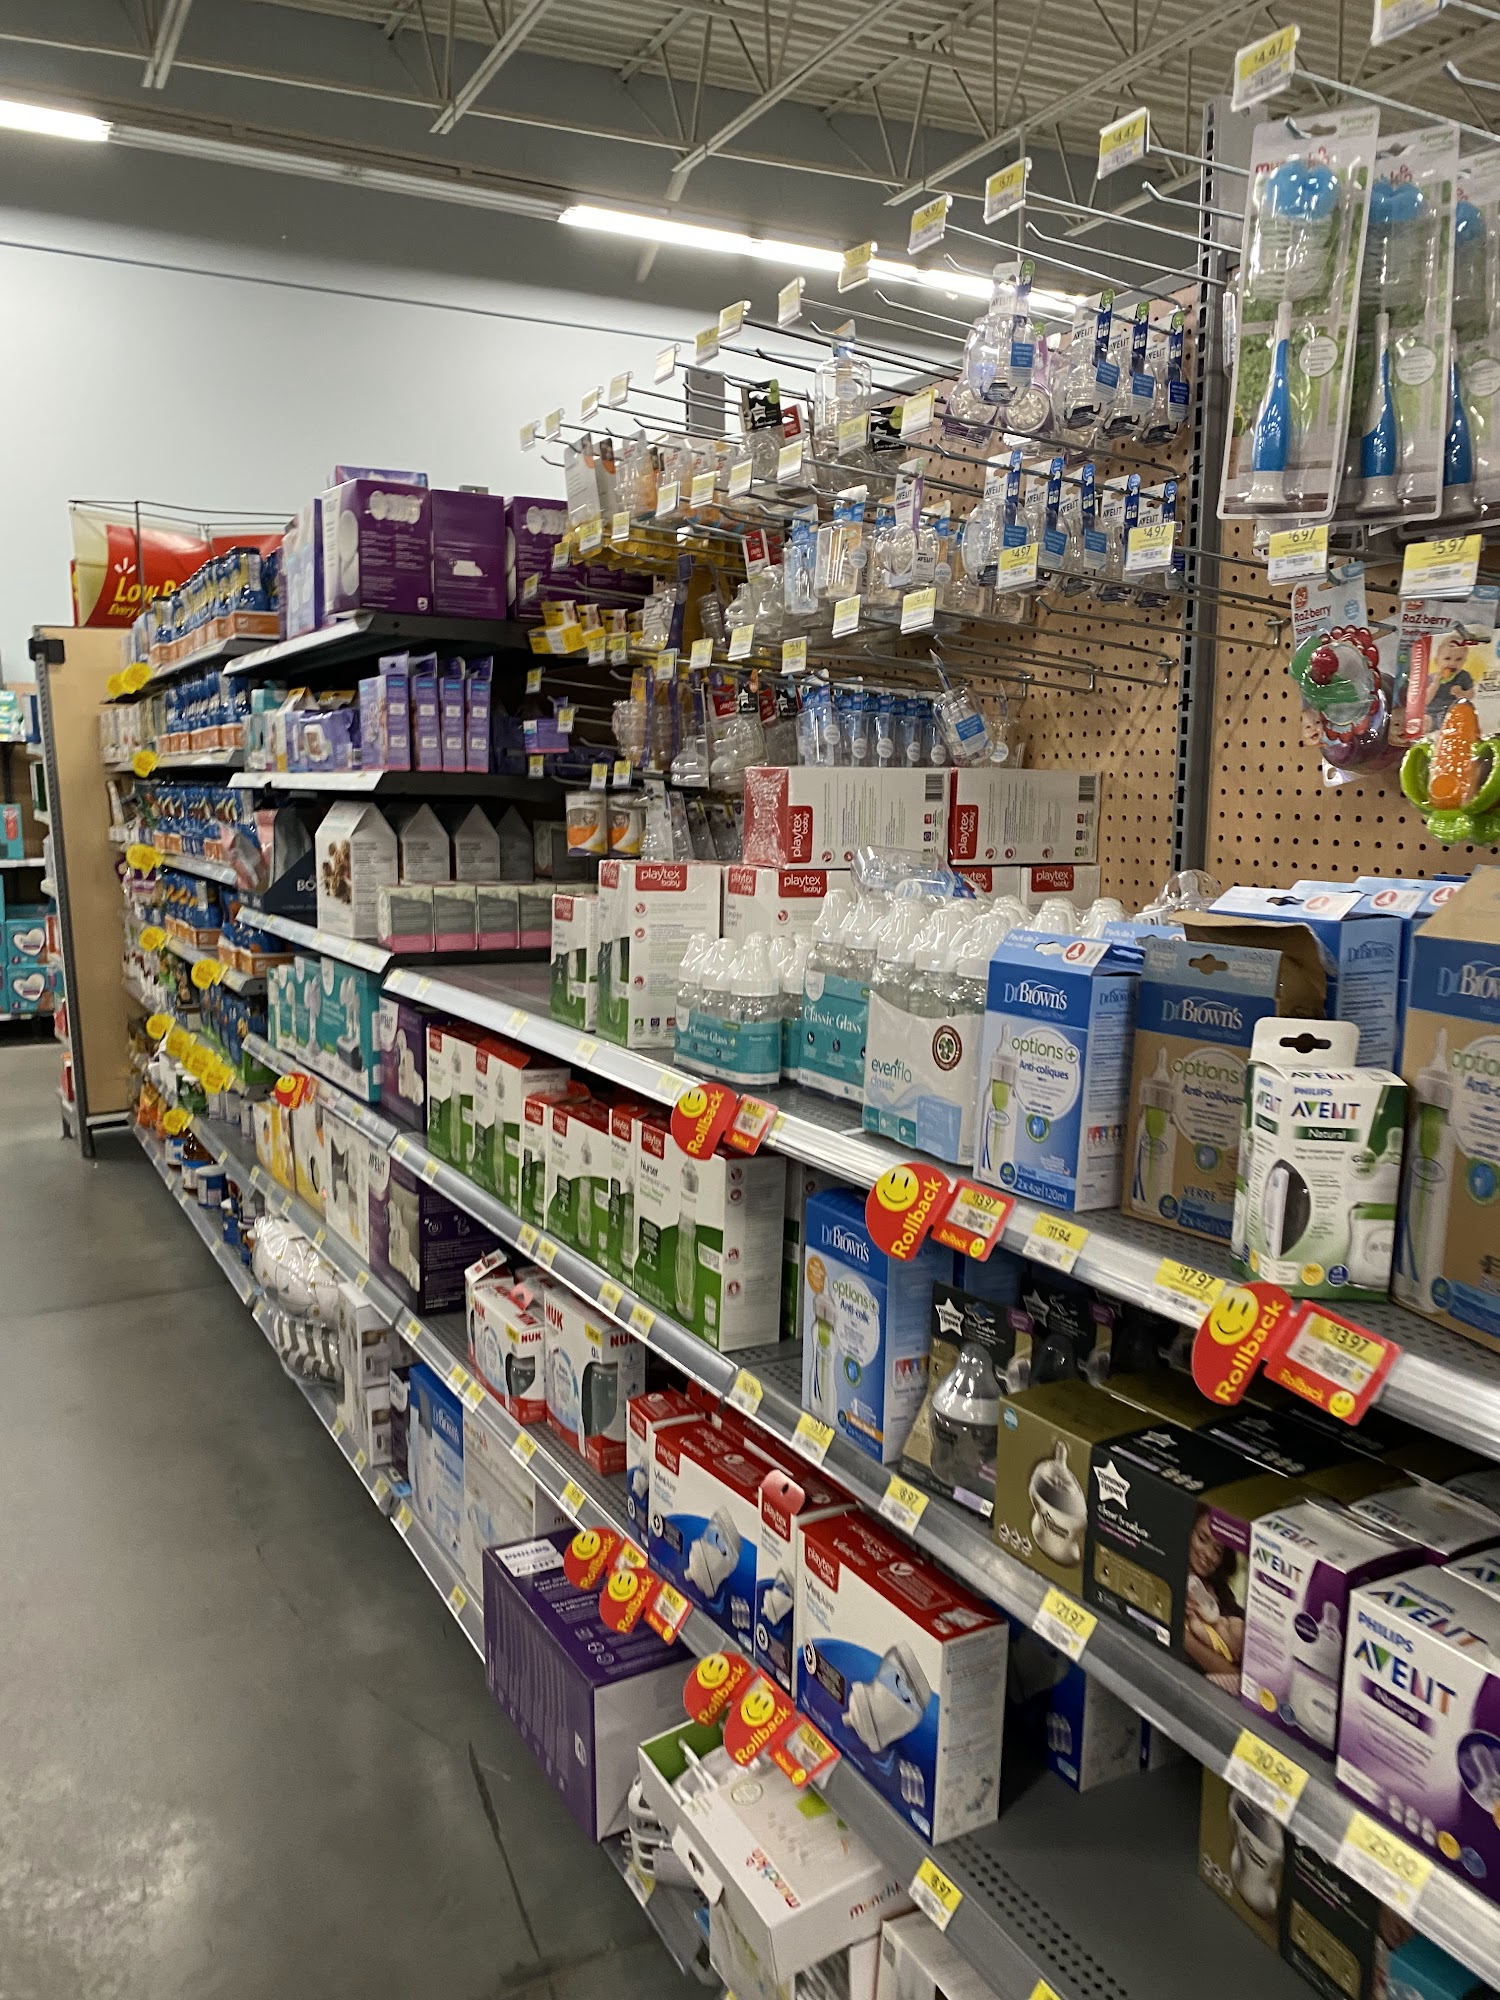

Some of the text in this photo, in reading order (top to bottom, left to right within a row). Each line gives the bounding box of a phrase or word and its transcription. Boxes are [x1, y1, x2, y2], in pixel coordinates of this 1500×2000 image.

[1143, 525, 1167, 538] $4.97
[1288, 527, 1316, 543] $6.97
[1432, 537, 1466, 555] $5.97
[801, 812, 811, 835] baby
[959, 810, 970, 855] playtex
[969, 810, 977, 832] baby
[792, 812, 803, 859] playtex
[641, 869, 681, 883] playtex
[661, 878, 682, 888] baby
[783, 873, 822, 889] playtex
[803, 883, 824, 894] baby
[1035, 870, 1070, 884] playtex
[1053, 879, 1070, 889] baby
[804, 1005, 862, 1035] Classic Glass
[1011, 1036, 1064, 1061] options
[871, 1057, 913, 1084] evenflo
[1172, 1058, 1240, 1085] options
[1291, 1071, 1356, 1081] AVENT
[1181, 1083, 1246, 1106] Anti-colique
[1294, 1086, 1334, 1098] PHILIPS
[687, 1089, 725, 1154] Rollback
[1291, 1100, 1362, 1120] AVENT
[1308, 1128, 1348, 1141] Natural
[640, 1158, 659, 1178] Nurser
[1182, 1186, 1217, 1201] VERRE
[890, 1177, 942, 1260] Rollback
[1048, 1225, 1073, 1244] $11.94
[1178, 1264, 1216, 1290] $17.97
[833, 1279, 870, 1309] options
[546, 1303, 563, 1331] NUK
[521, 1332, 542, 1343] NUK
[1329, 1322, 1371, 1352] $13.97
[1214, 1300, 1286, 1403] Rollback
[763, 1501, 786, 1529] playtex
[580, 1535, 614, 1590] Rollback
[807, 1546, 836, 1578] playtex
[1252, 1547, 1304, 1584] AVENT
[616, 1576, 654, 1634] Rollback
[1368, 1590, 1490, 1648] AVENT
[1358, 1610, 1415, 1655] PHILIPS
[1353, 1638, 1459, 1716] AVENT
[698, 1664, 747, 1725] Rollback
[735, 1705, 791, 1765] Rollback
